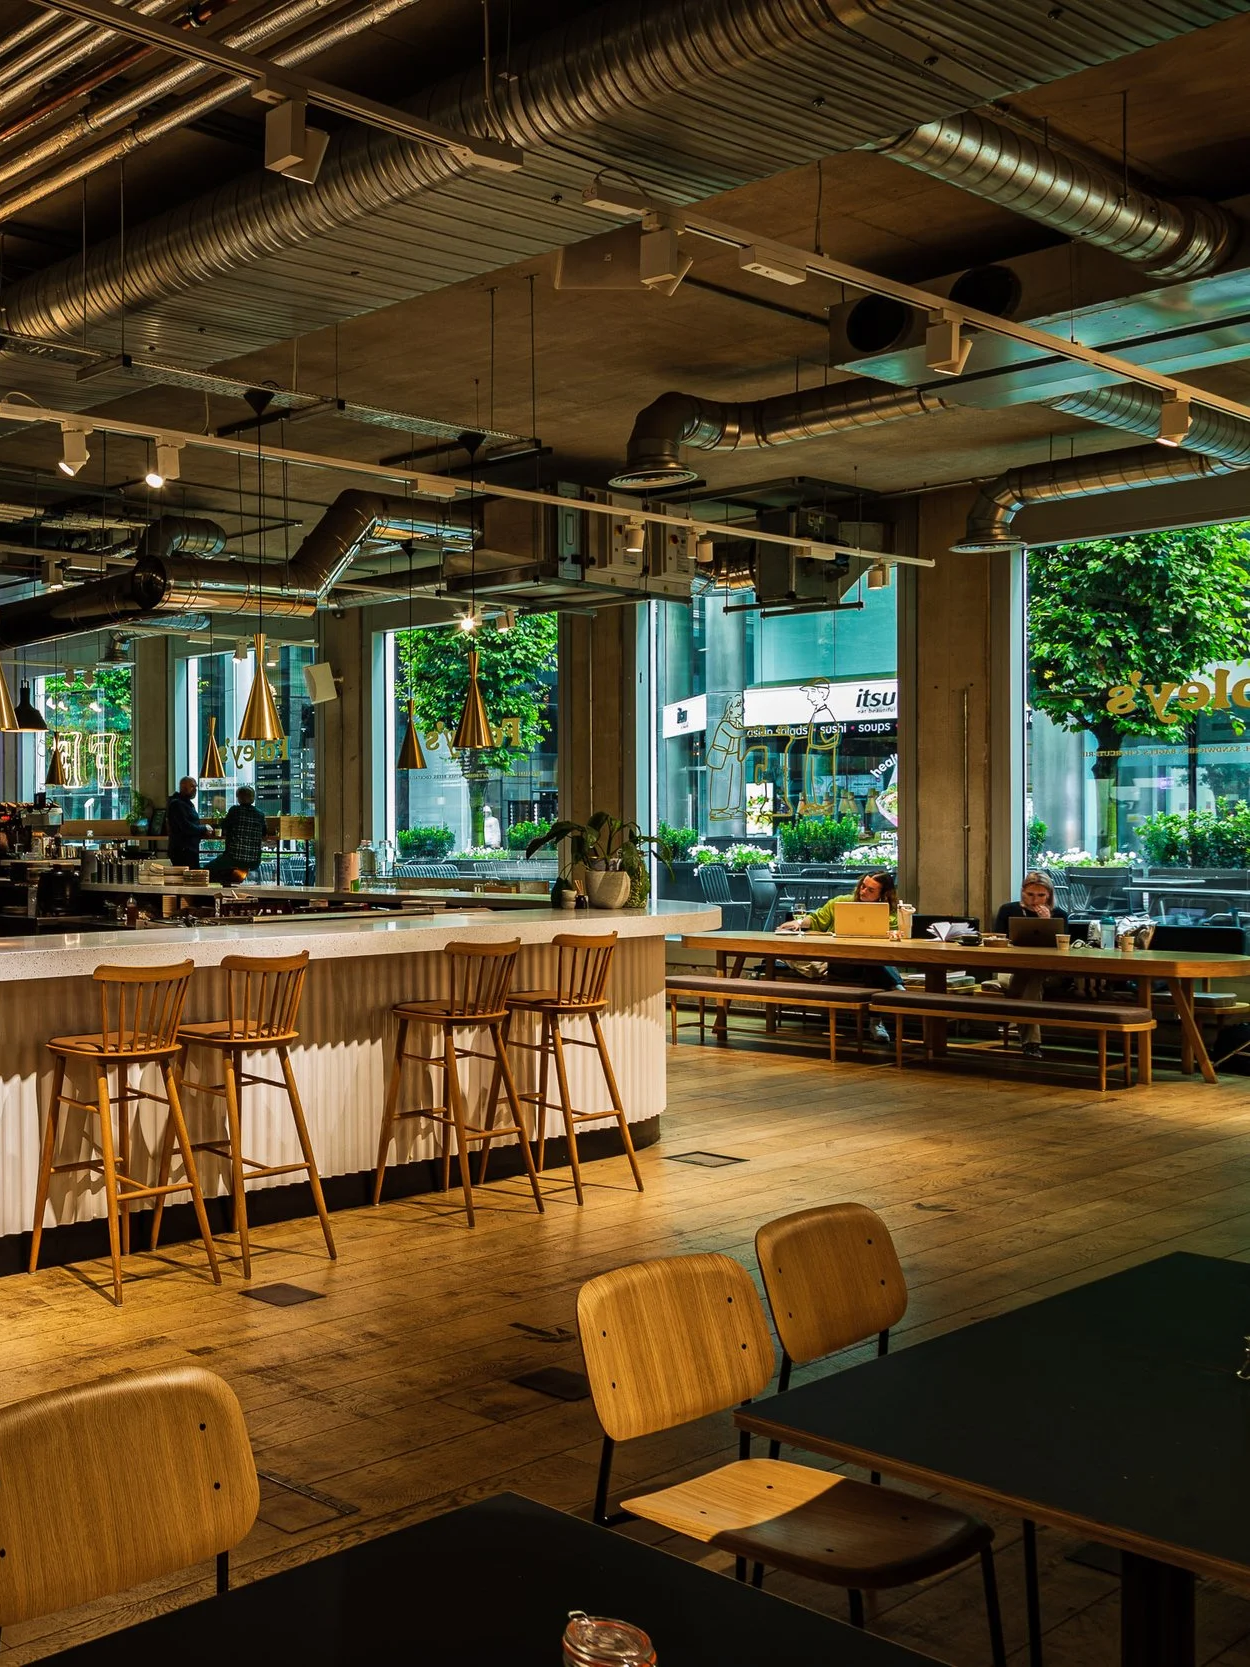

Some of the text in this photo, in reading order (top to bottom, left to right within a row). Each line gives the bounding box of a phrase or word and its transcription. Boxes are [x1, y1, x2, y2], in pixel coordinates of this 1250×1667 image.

[855, 688, 897, 708] itsu
[819, 723, 847, 735] sushi
[858, 722, 891, 734] soups
